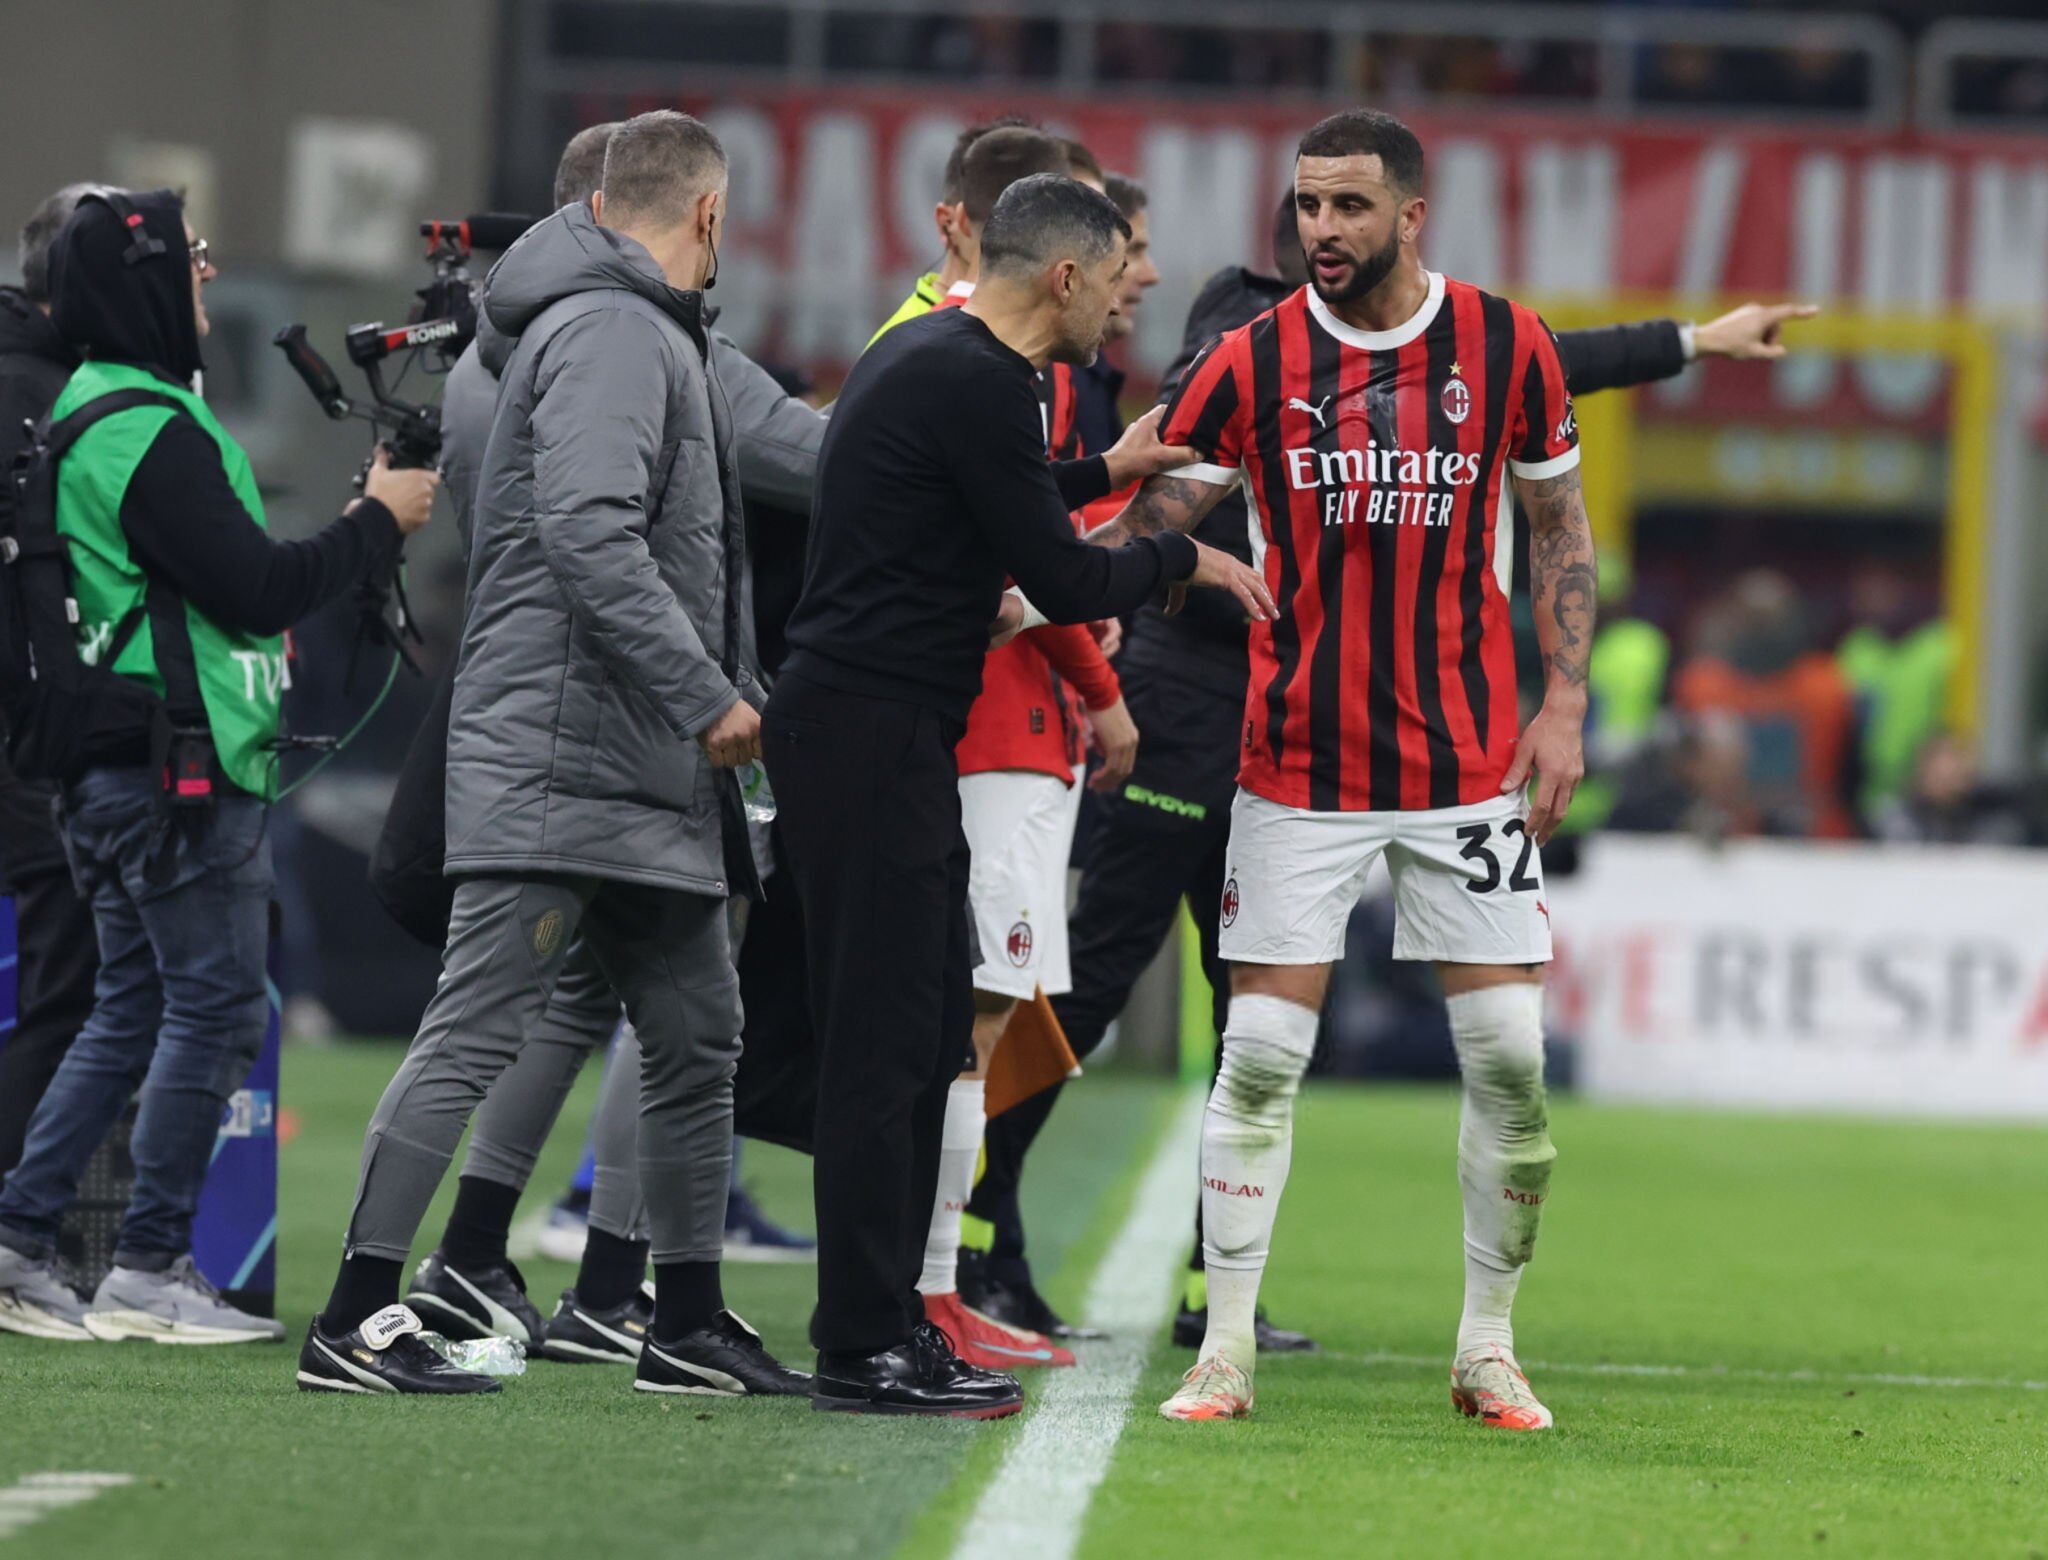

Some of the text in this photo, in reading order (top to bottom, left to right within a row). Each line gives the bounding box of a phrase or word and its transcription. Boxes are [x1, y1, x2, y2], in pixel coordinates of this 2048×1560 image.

[405, 320, 459, 345] RONIN
[1286, 440, 1481, 490] Emirates
[1324, 489, 1454, 526] FLY BETTER
[1456, 818, 1540, 894] 32
[1203, 1176, 1264, 1198] MILAN
[378, 1317, 407, 1336] PUMA
